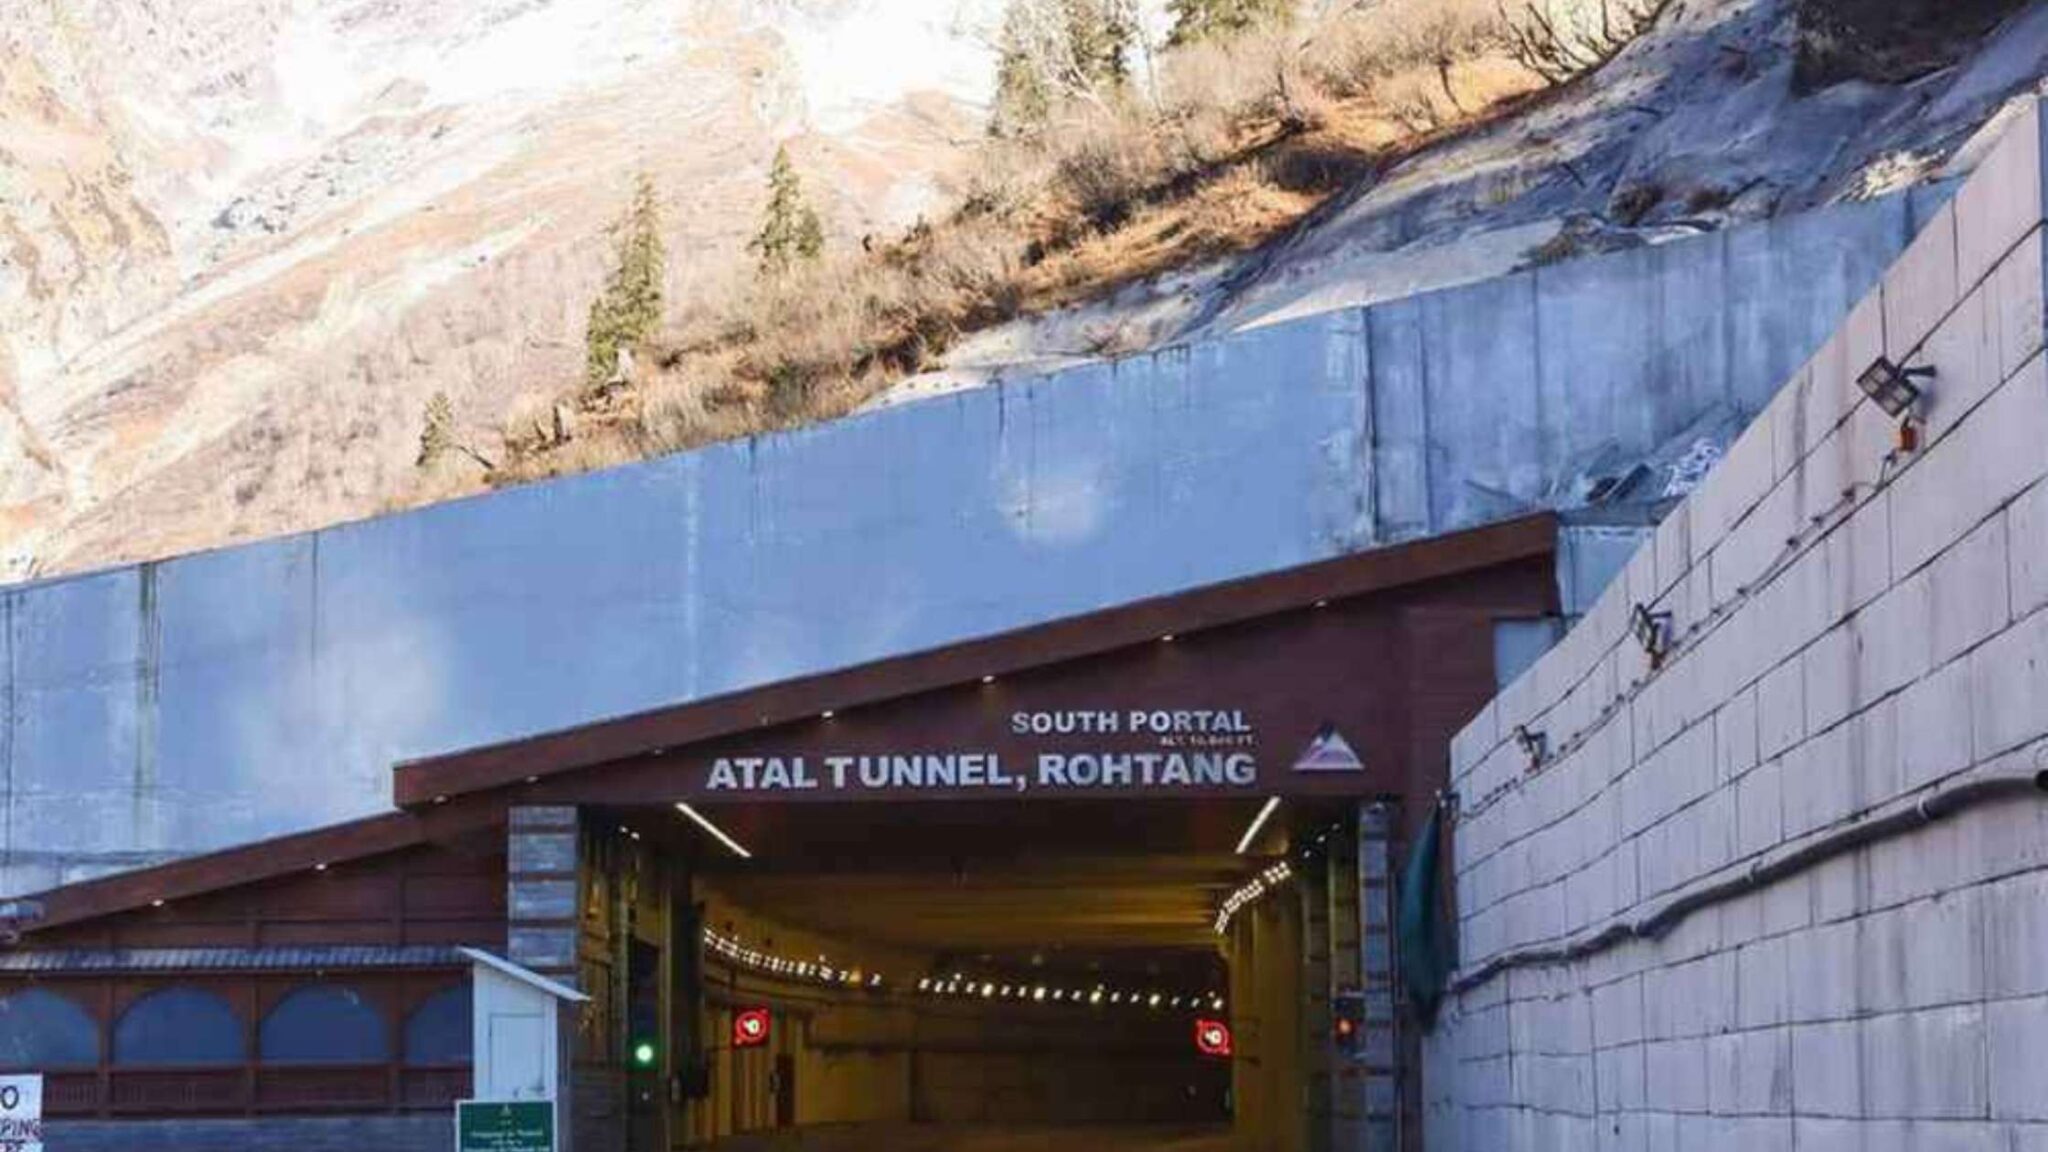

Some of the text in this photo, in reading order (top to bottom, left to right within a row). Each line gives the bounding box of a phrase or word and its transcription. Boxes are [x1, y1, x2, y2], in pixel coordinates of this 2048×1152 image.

[1012, 710, 1250, 733] SOUTH PORTAL
[706, 753, 1256, 792] ATAL TUNNEL, ROHTANG
